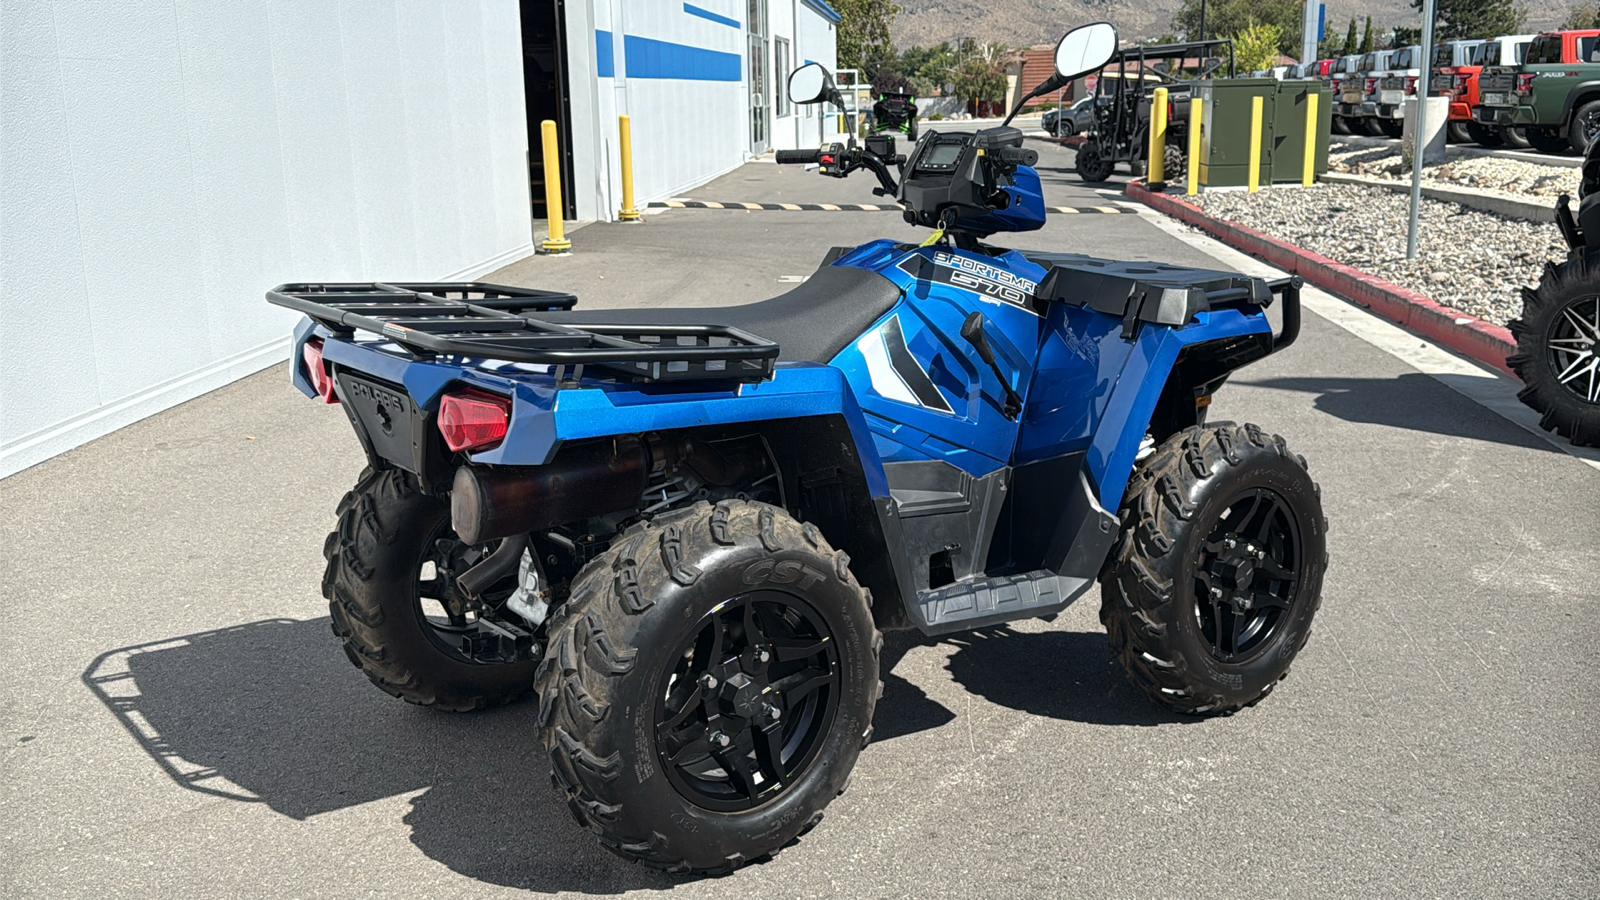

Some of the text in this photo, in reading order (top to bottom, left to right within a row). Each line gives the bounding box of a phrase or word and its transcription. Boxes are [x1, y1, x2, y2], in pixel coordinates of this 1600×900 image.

[933, 251, 1037, 296] SPORTSMA
[950, 270, 1026, 305] 570
[351, 381, 403, 411] POLARIS
[742, 558, 828, 591] CST
